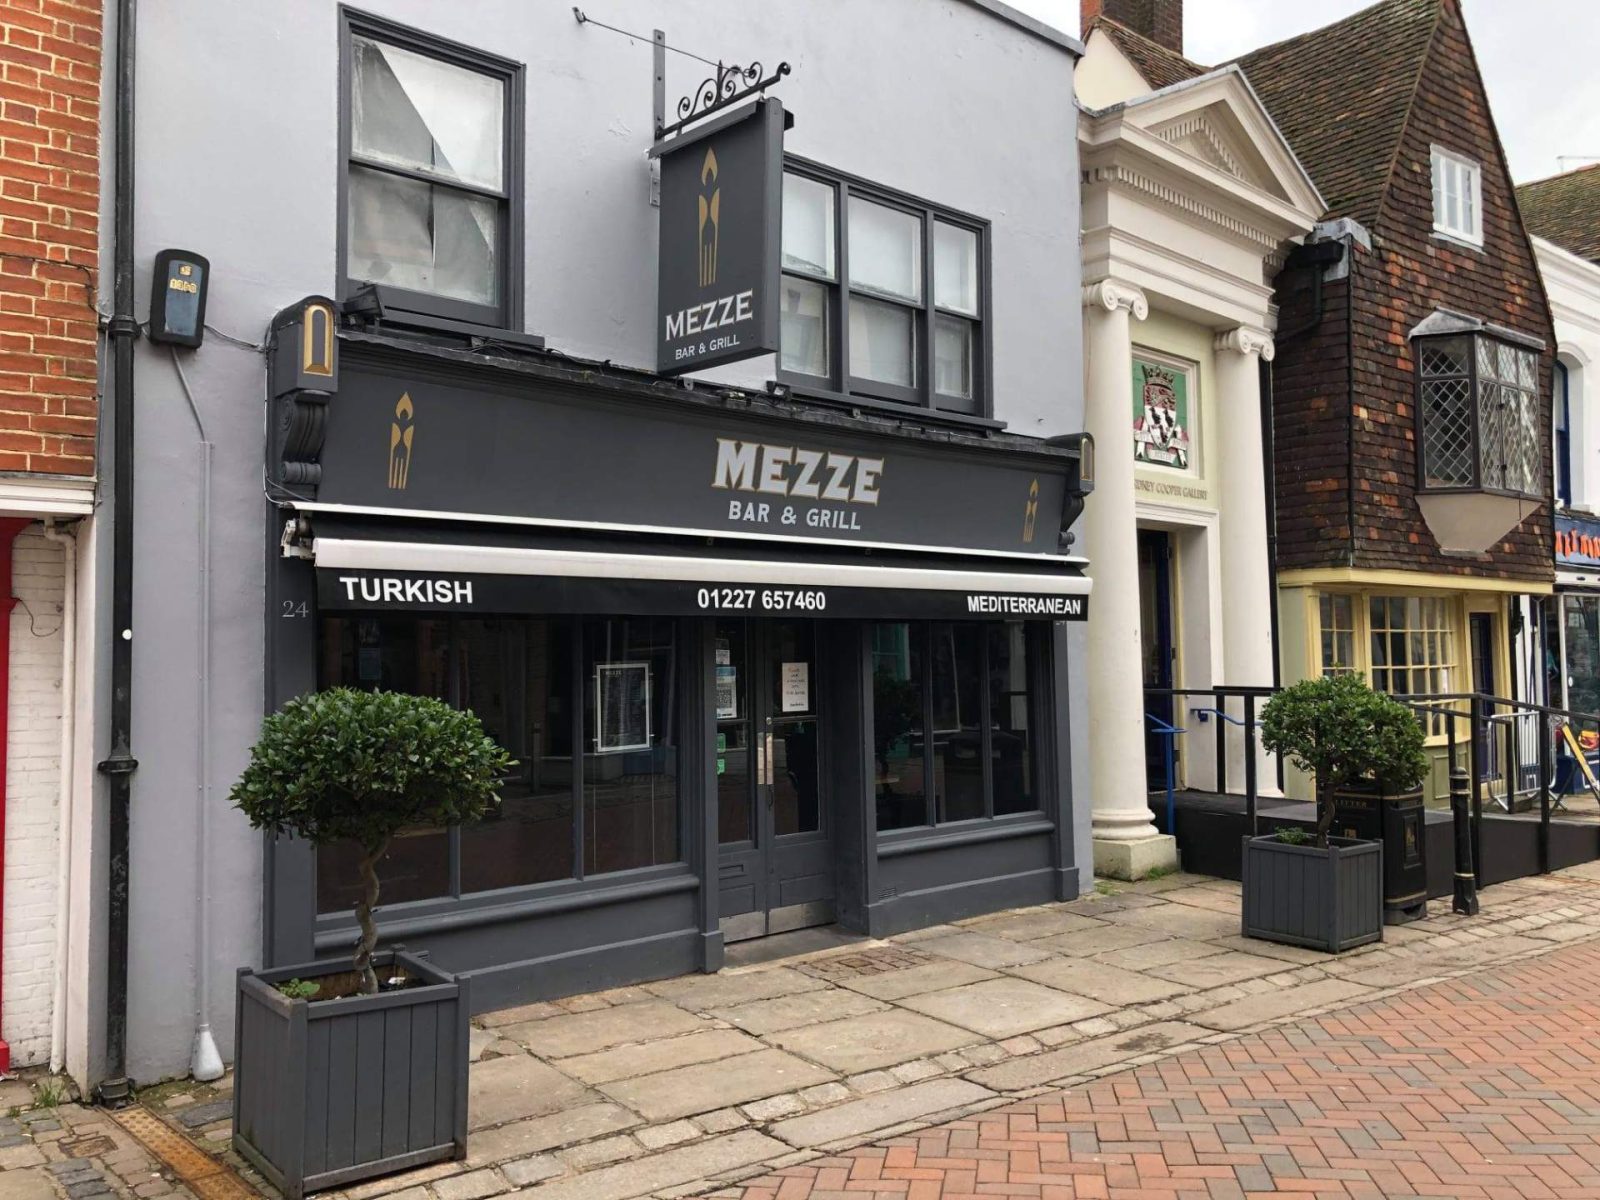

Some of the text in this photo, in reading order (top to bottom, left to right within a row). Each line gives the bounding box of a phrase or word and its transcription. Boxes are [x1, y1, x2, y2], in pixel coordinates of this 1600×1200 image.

[665, 288, 753, 342] MEZZE
[675, 334, 740, 360] BAR & GRILL
[711, 437, 885, 507] MEZZE
[1182, 487, 1207, 500] GALLERY
[728, 500, 861, 530] BAR & GRILL
[339, 576, 473, 604] TURKISH
[697, 588, 826, 611] 01227 657460
[282, 600, 309, 618] 24
[967, 595, 1081, 615] MEDITERRANEAN
